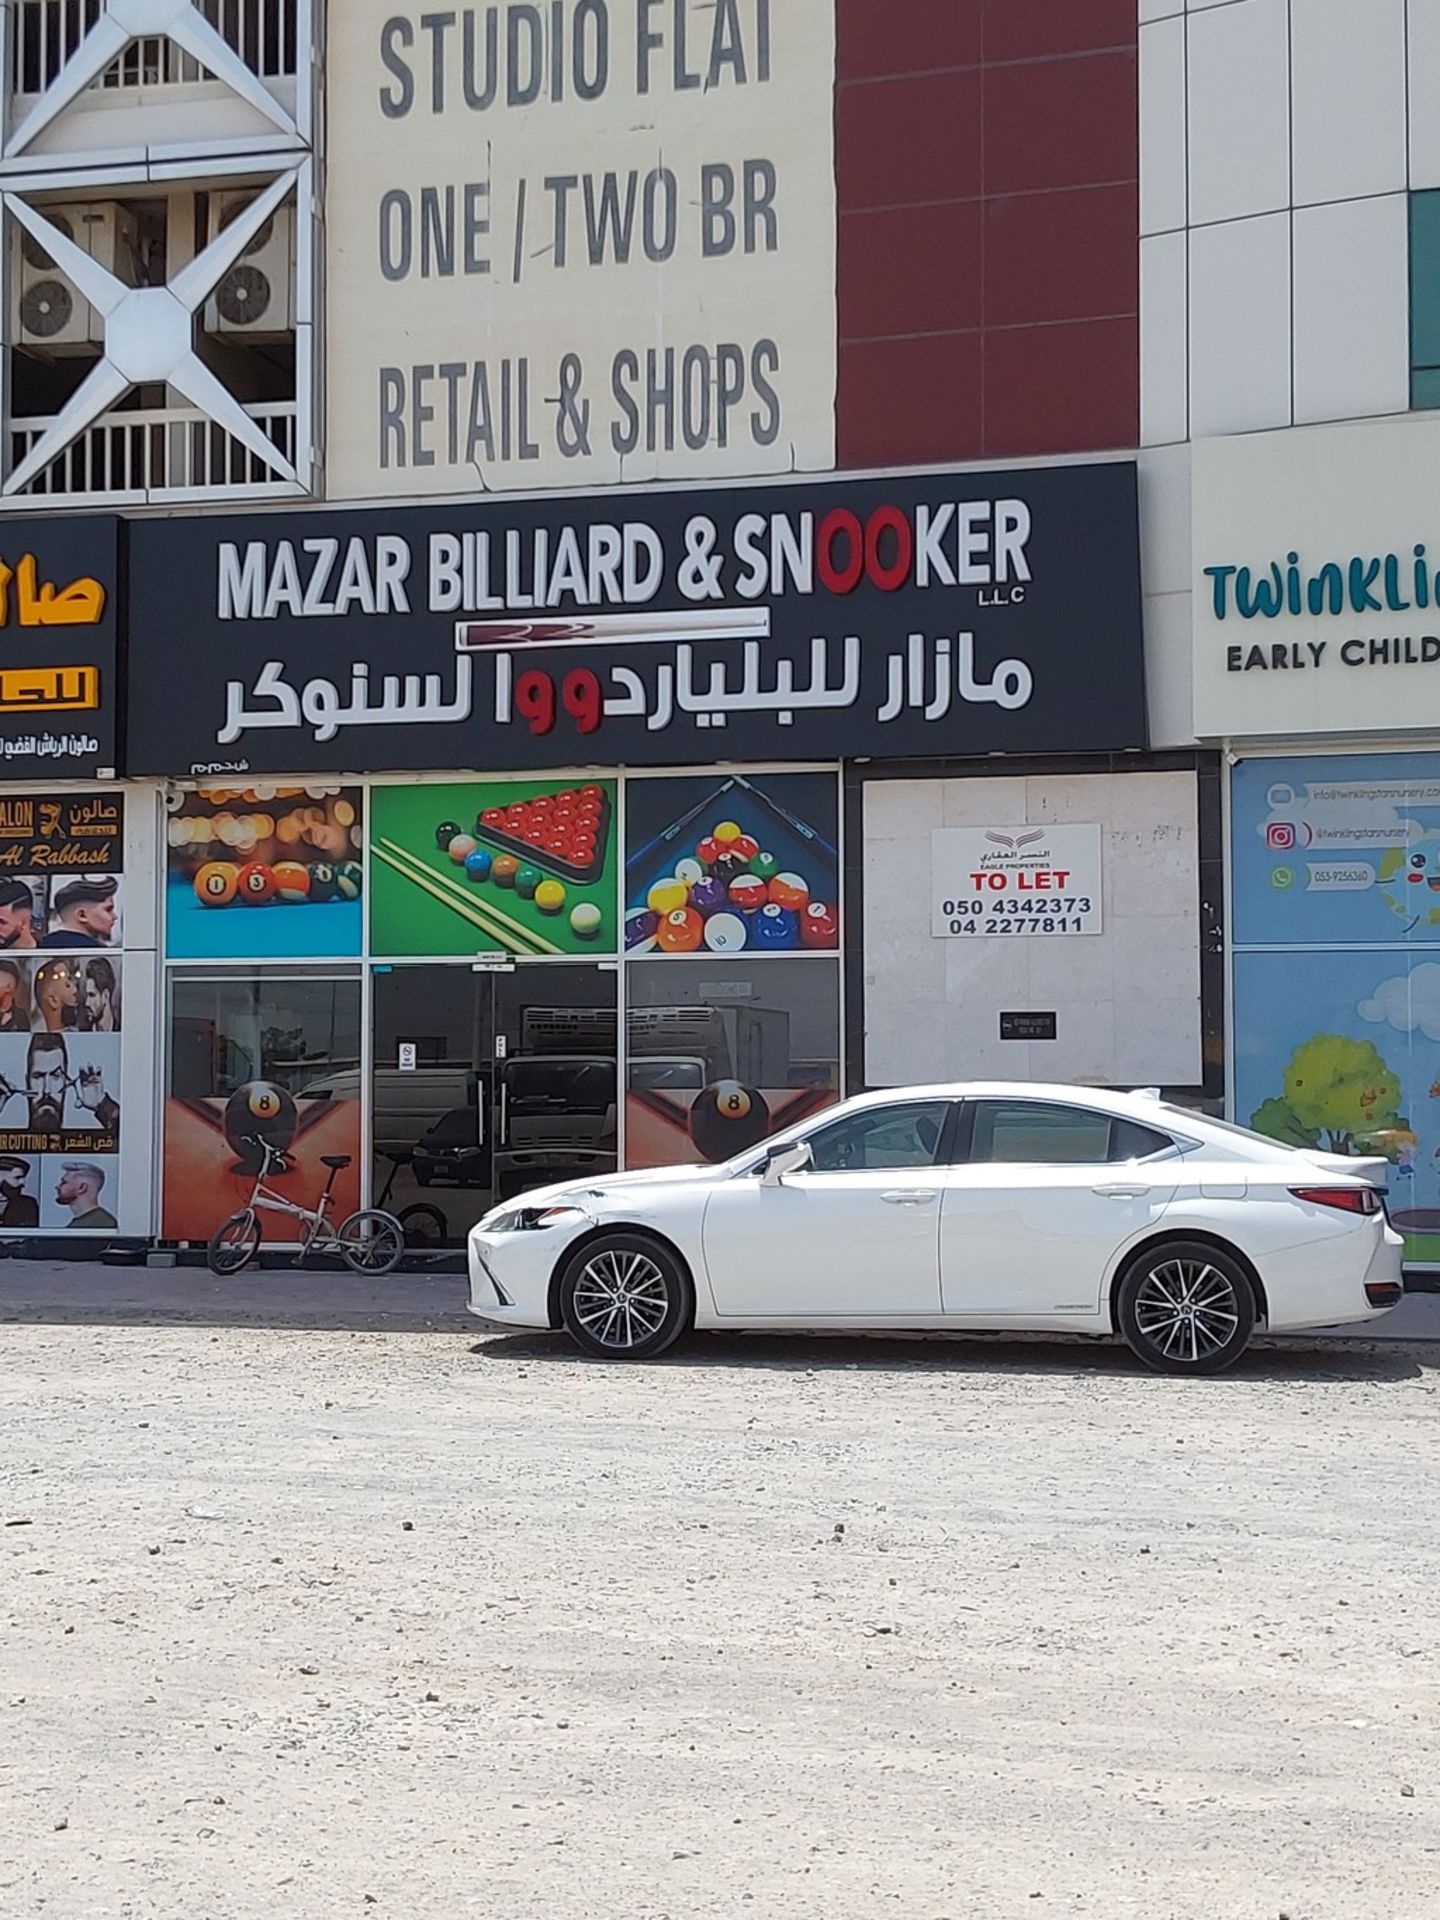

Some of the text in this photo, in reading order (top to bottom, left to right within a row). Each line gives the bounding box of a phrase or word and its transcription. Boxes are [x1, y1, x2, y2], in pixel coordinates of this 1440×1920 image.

[379, 0, 609, 119] STUDIO
[379, 183, 492, 282] ONE
[545, 169, 677, 268] TWO
[701, 158, 779, 258] BR
[379, 339, 781, 469] RETAIL & SHOPS
[218, 498, 1032, 619] MAZAR BILLIARD & SNOOKER
[1227, 641, 1327, 672] EARLY
[603, 635, 861, 732] للبليارد
[878, 631, 1034, 722] مازار
[69, 734, 98, 757] صالون
[70, 799, 117, 823] صالون
[1005, 862, 1050, 870] PROPERTIES
[1019, 850, 1050, 861] النسر
[970, 871, 1070, 891] TO LET
[943, 898, 1091, 915] 050 4342373
[950, 917, 1081, 934] 04 2277811
[260, 1094, 270, 1111] 8
[728, 1093, 740, 1111] 8
[9, 1134, 47, 1151] CUTTING
[64, 1134, 113, 1151] قص الشعر
